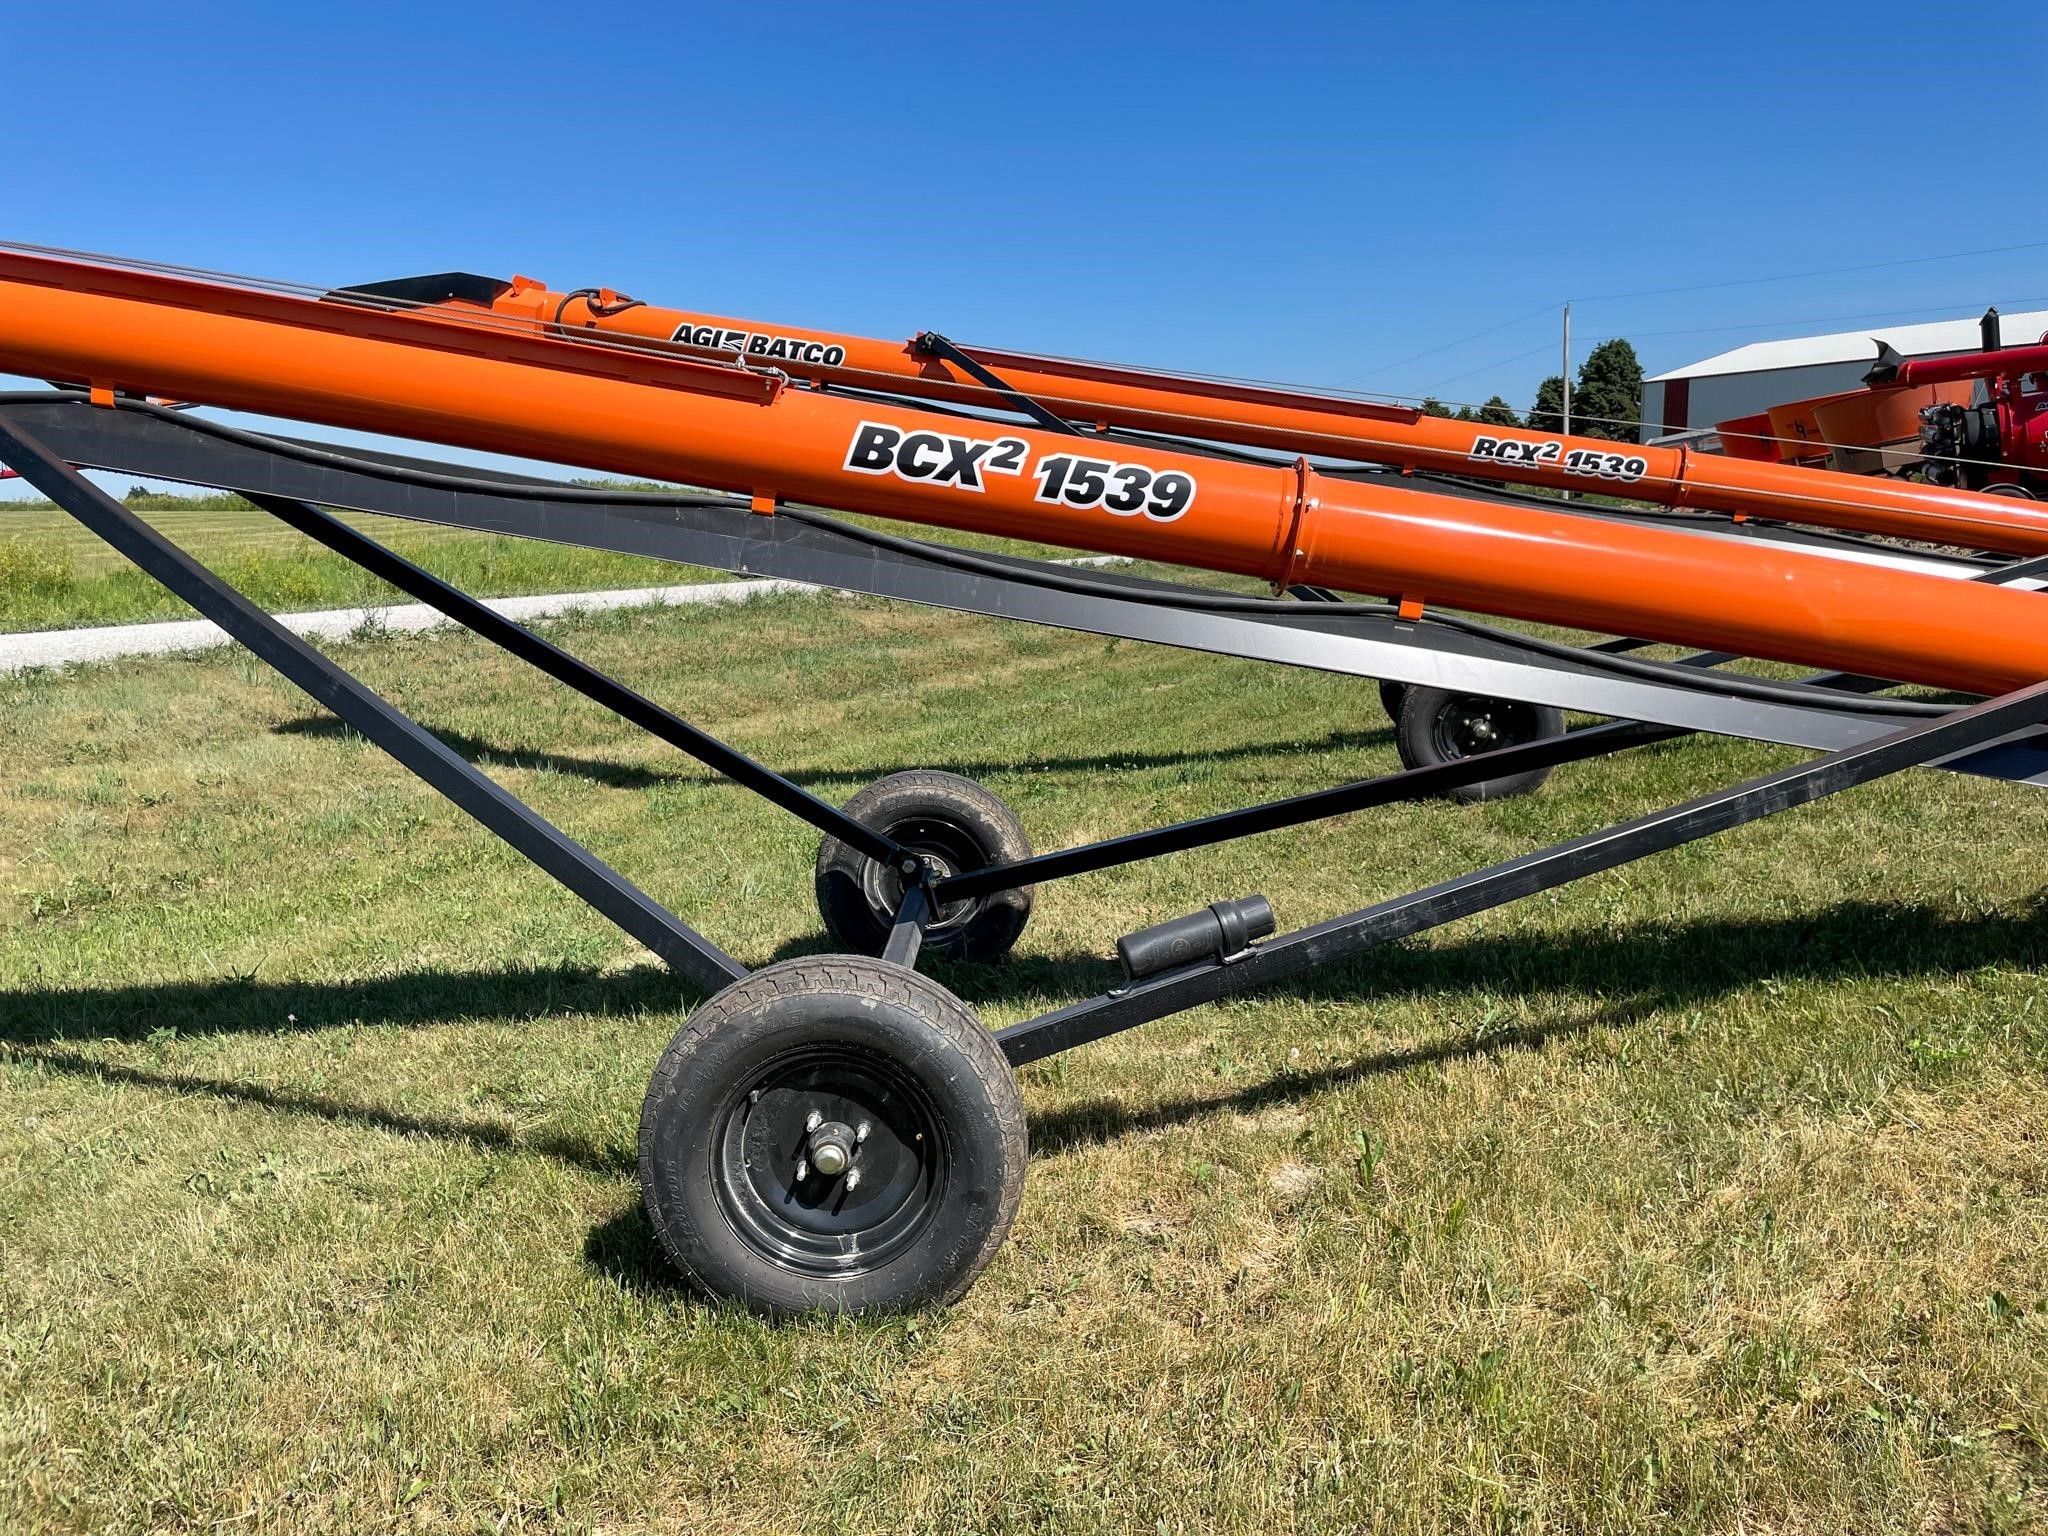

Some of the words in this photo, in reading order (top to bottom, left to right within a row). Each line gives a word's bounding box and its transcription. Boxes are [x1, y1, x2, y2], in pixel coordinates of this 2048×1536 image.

[671, 324, 724, 348] AGI
[748, 334, 845, 366] BATCO
[1565, 450, 1646, 481] 1539
[1039, 456, 1193, 518] 1539
